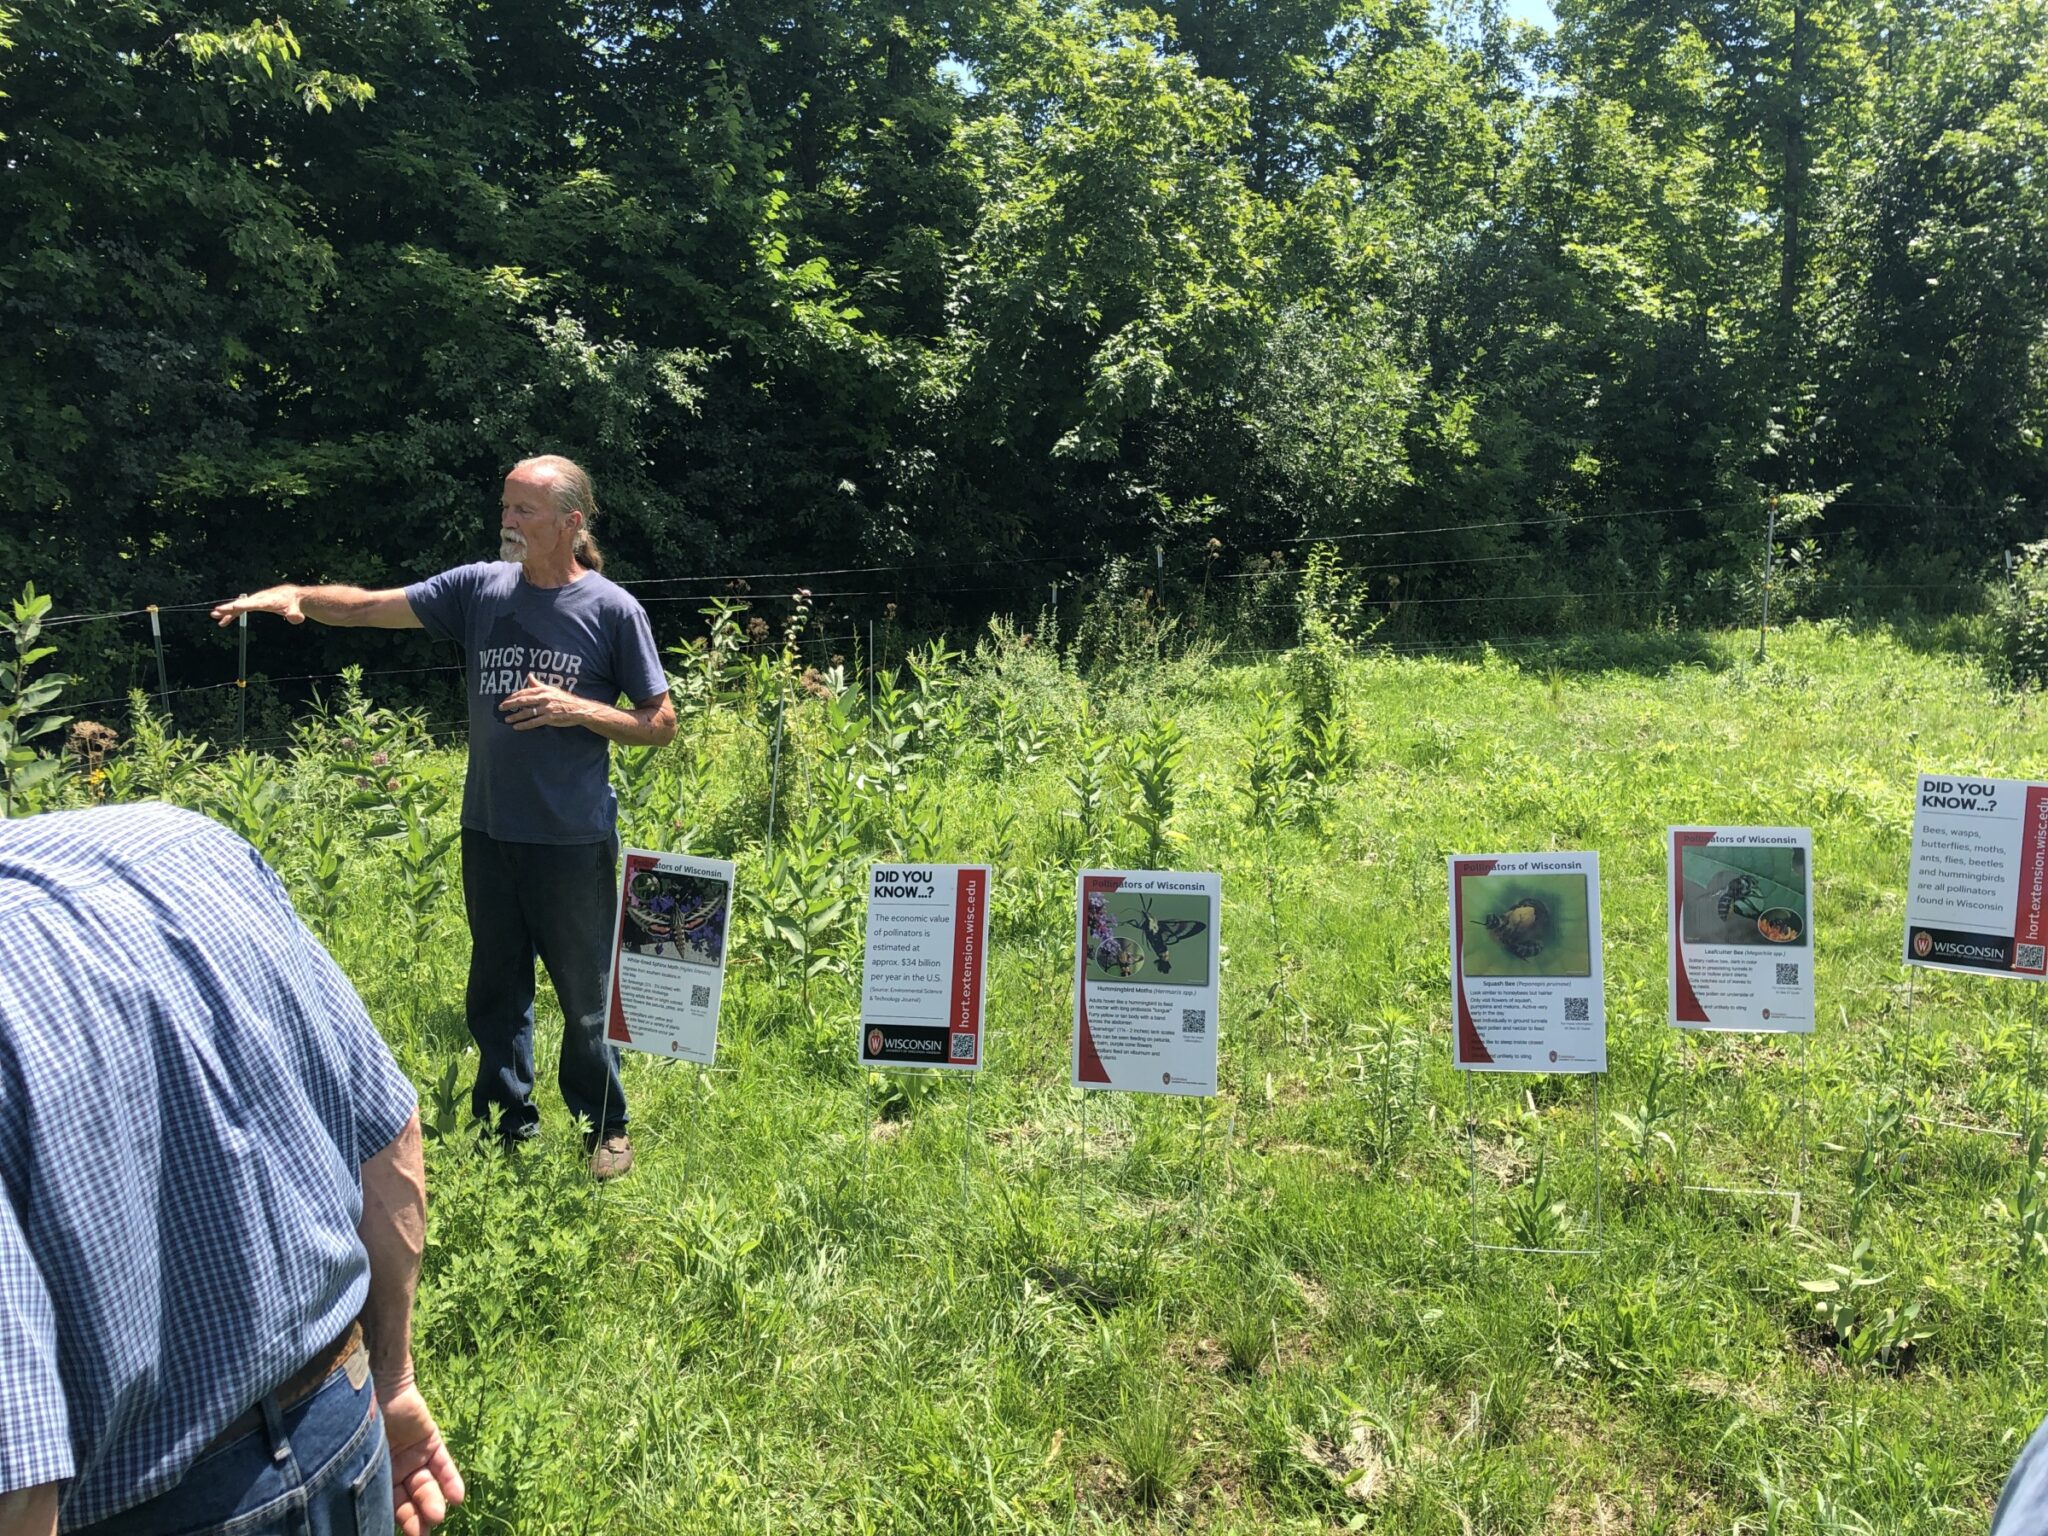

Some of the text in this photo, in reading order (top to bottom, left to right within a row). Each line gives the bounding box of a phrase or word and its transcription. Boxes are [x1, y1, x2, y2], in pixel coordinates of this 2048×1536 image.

[479, 644, 582, 674] WHO'S YOUR
[1924, 781, 1995, 796] DID YOU
[1922, 795, 1997, 811] KNOW...?
[1923, 825, 1981, 839] Bees, wasps,
[1749, 836, 1796, 844] Wisconsin
[1922, 840, 2006, 855] butterflies, moths,
[1531, 861, 1581, 870] Wisconsin
[1920, 855, 2003, 868] ants, flies, beetles
[684, 866, 722, 877] Wisconsin
[1919, 868, 2005, 882] and hummingbirds
[2026, 798, 2048, 940] hort.extension.wisc.edu
[876, 871, 932, 882] DID YOU
[874, 886, 934, 898] KNOW...?
[1157, 882, 1205, 891] Wisconsin
[1934, 883, 1945, 891] all
[1947, 885, 1996, 896] pollinators
[1917, 895, 1943, 905] found
[1957, 900, 2003, 911] Wisconsin
[883, 929, 922, 937] pollinators
[959, 880, 976, 1028] hort.extension.wisc.edu
[1934, 942, 2004, 959] WISCONSIN
[885, 974, 901, 982] year
[885, 1038, 942, 1050] WISCONSIN
